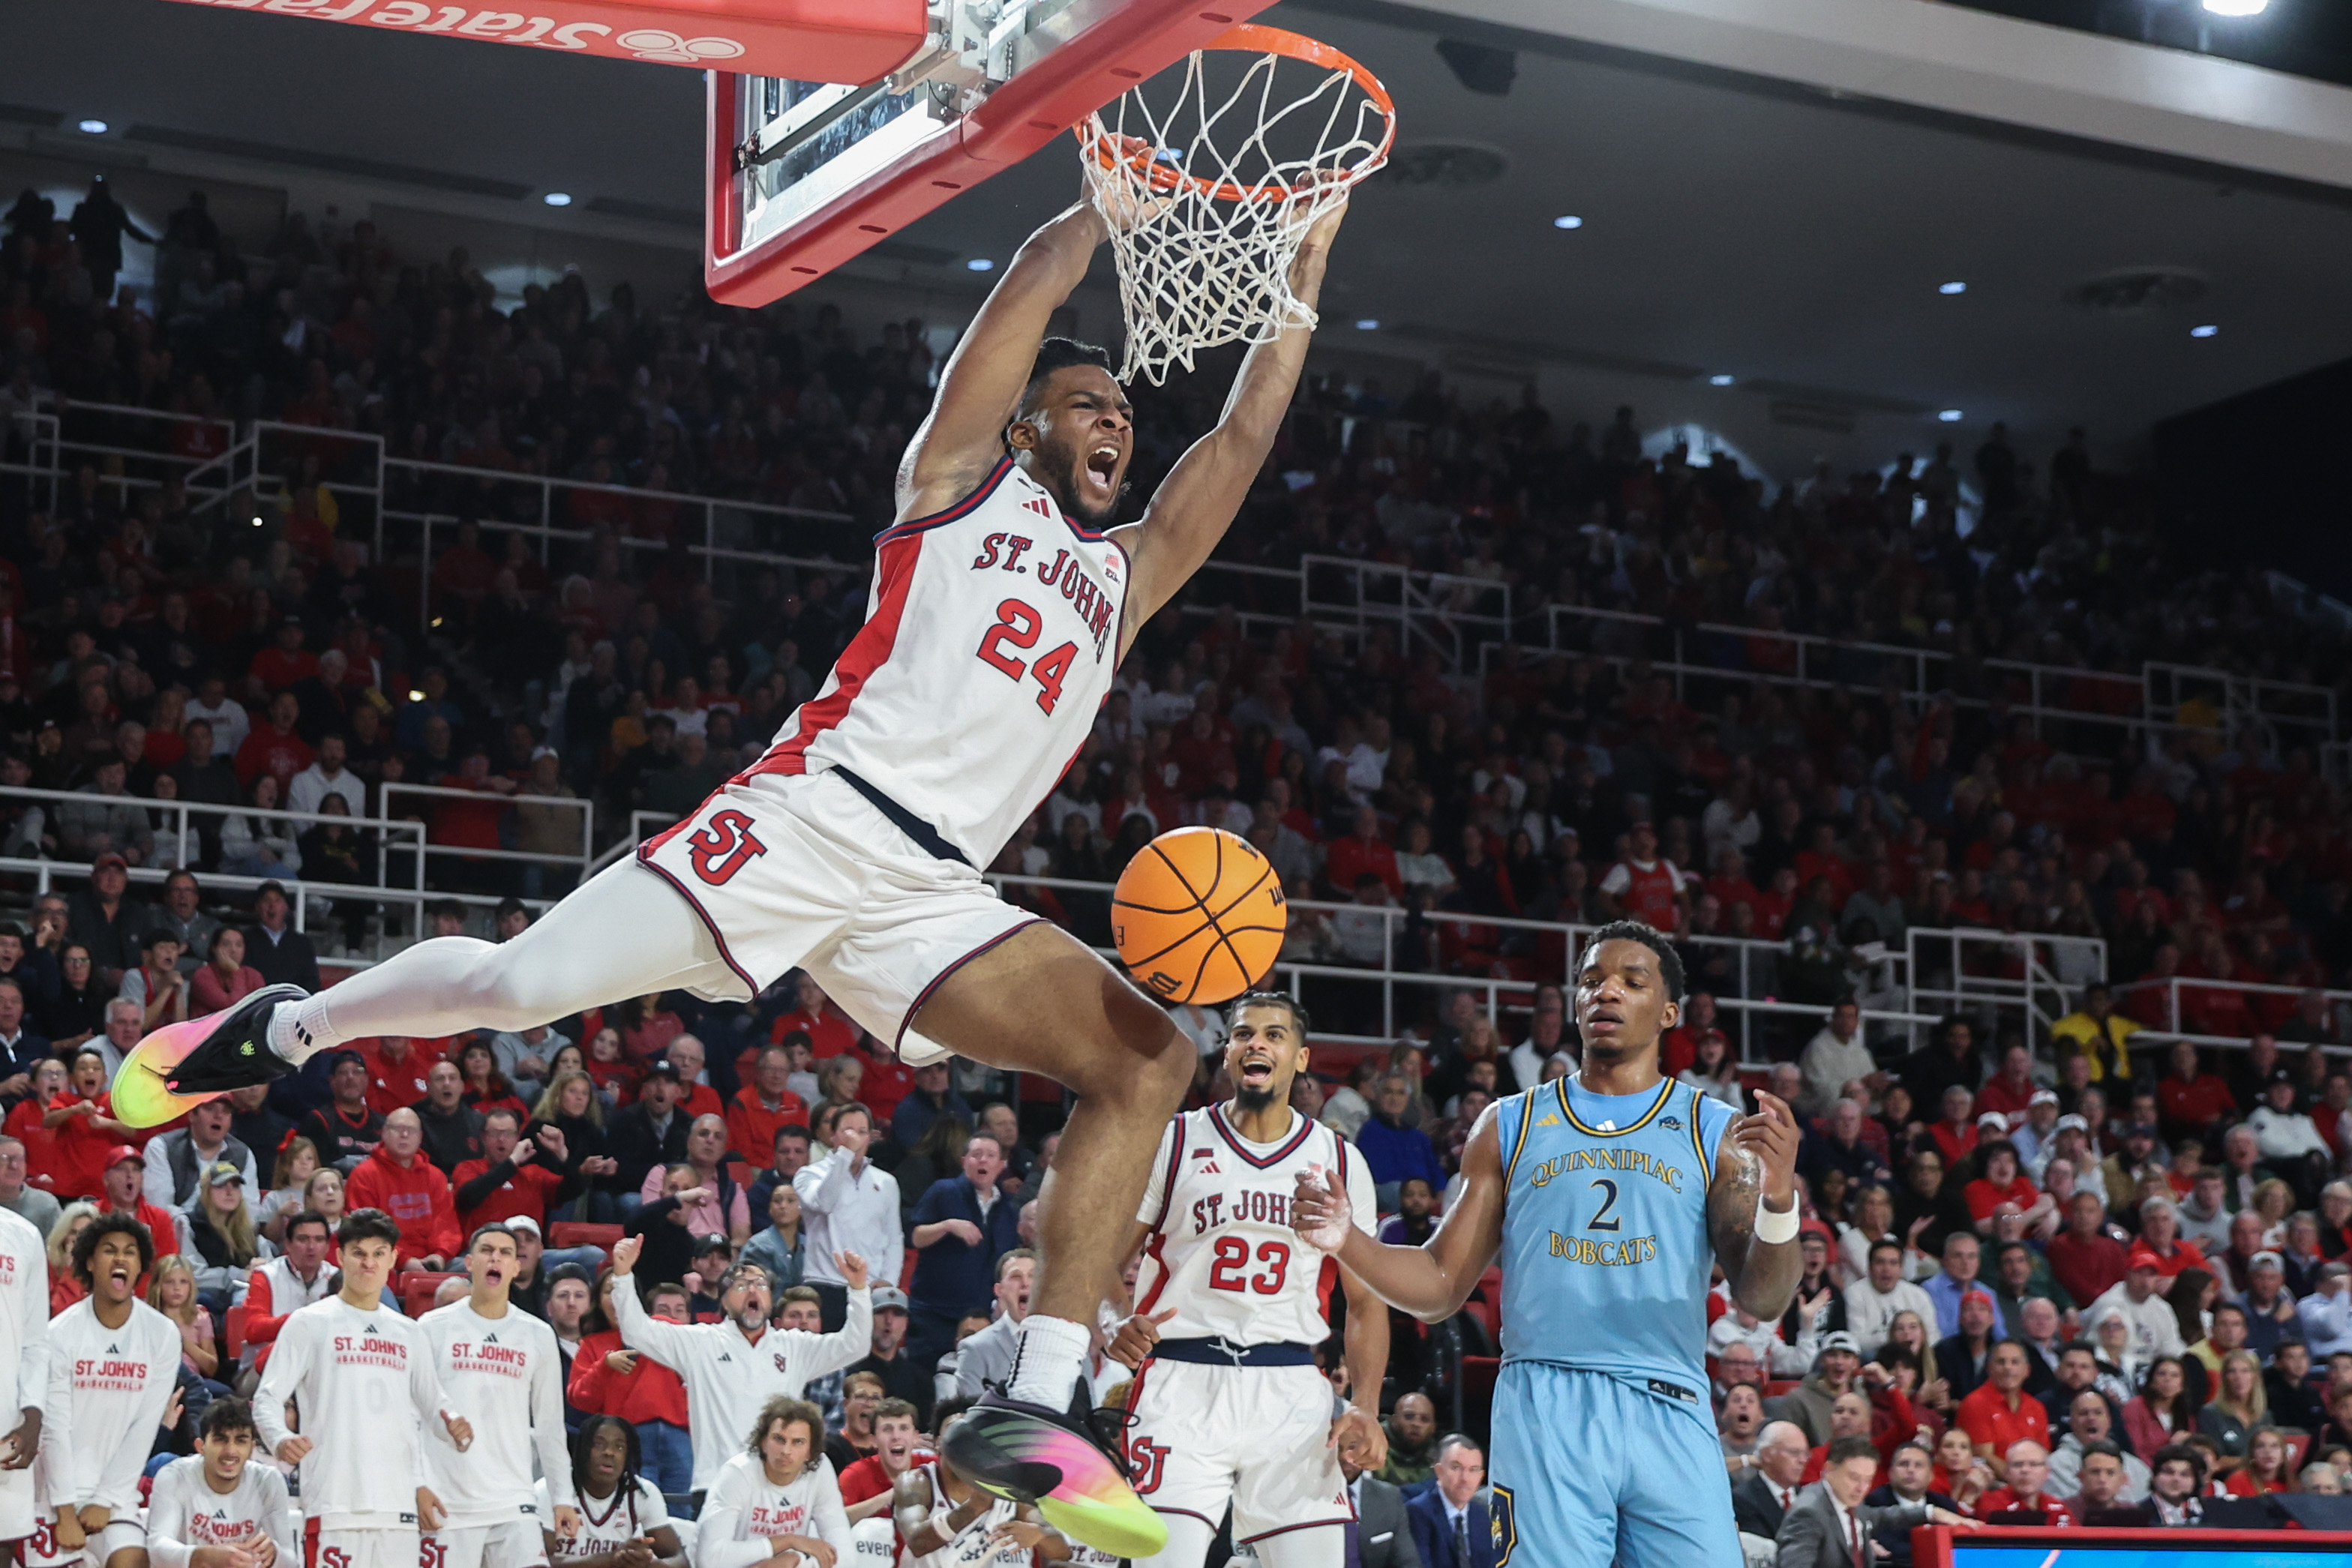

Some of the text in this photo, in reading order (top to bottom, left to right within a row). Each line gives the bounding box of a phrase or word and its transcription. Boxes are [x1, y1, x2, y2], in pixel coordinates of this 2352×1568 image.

[970, 532, 1034, 574] ST.
[976, 598, 1079, 718] 24
[1531, 1148, 1683, 1194] QUINNIPIAC
[1192, 1192, 1226, 1236] ST.
[1586, 1177, 1622, 1232] 2
[1209, 1235, 1291, 1295] 23
[1548, 1229, 1657, 1267] BOBCATS
